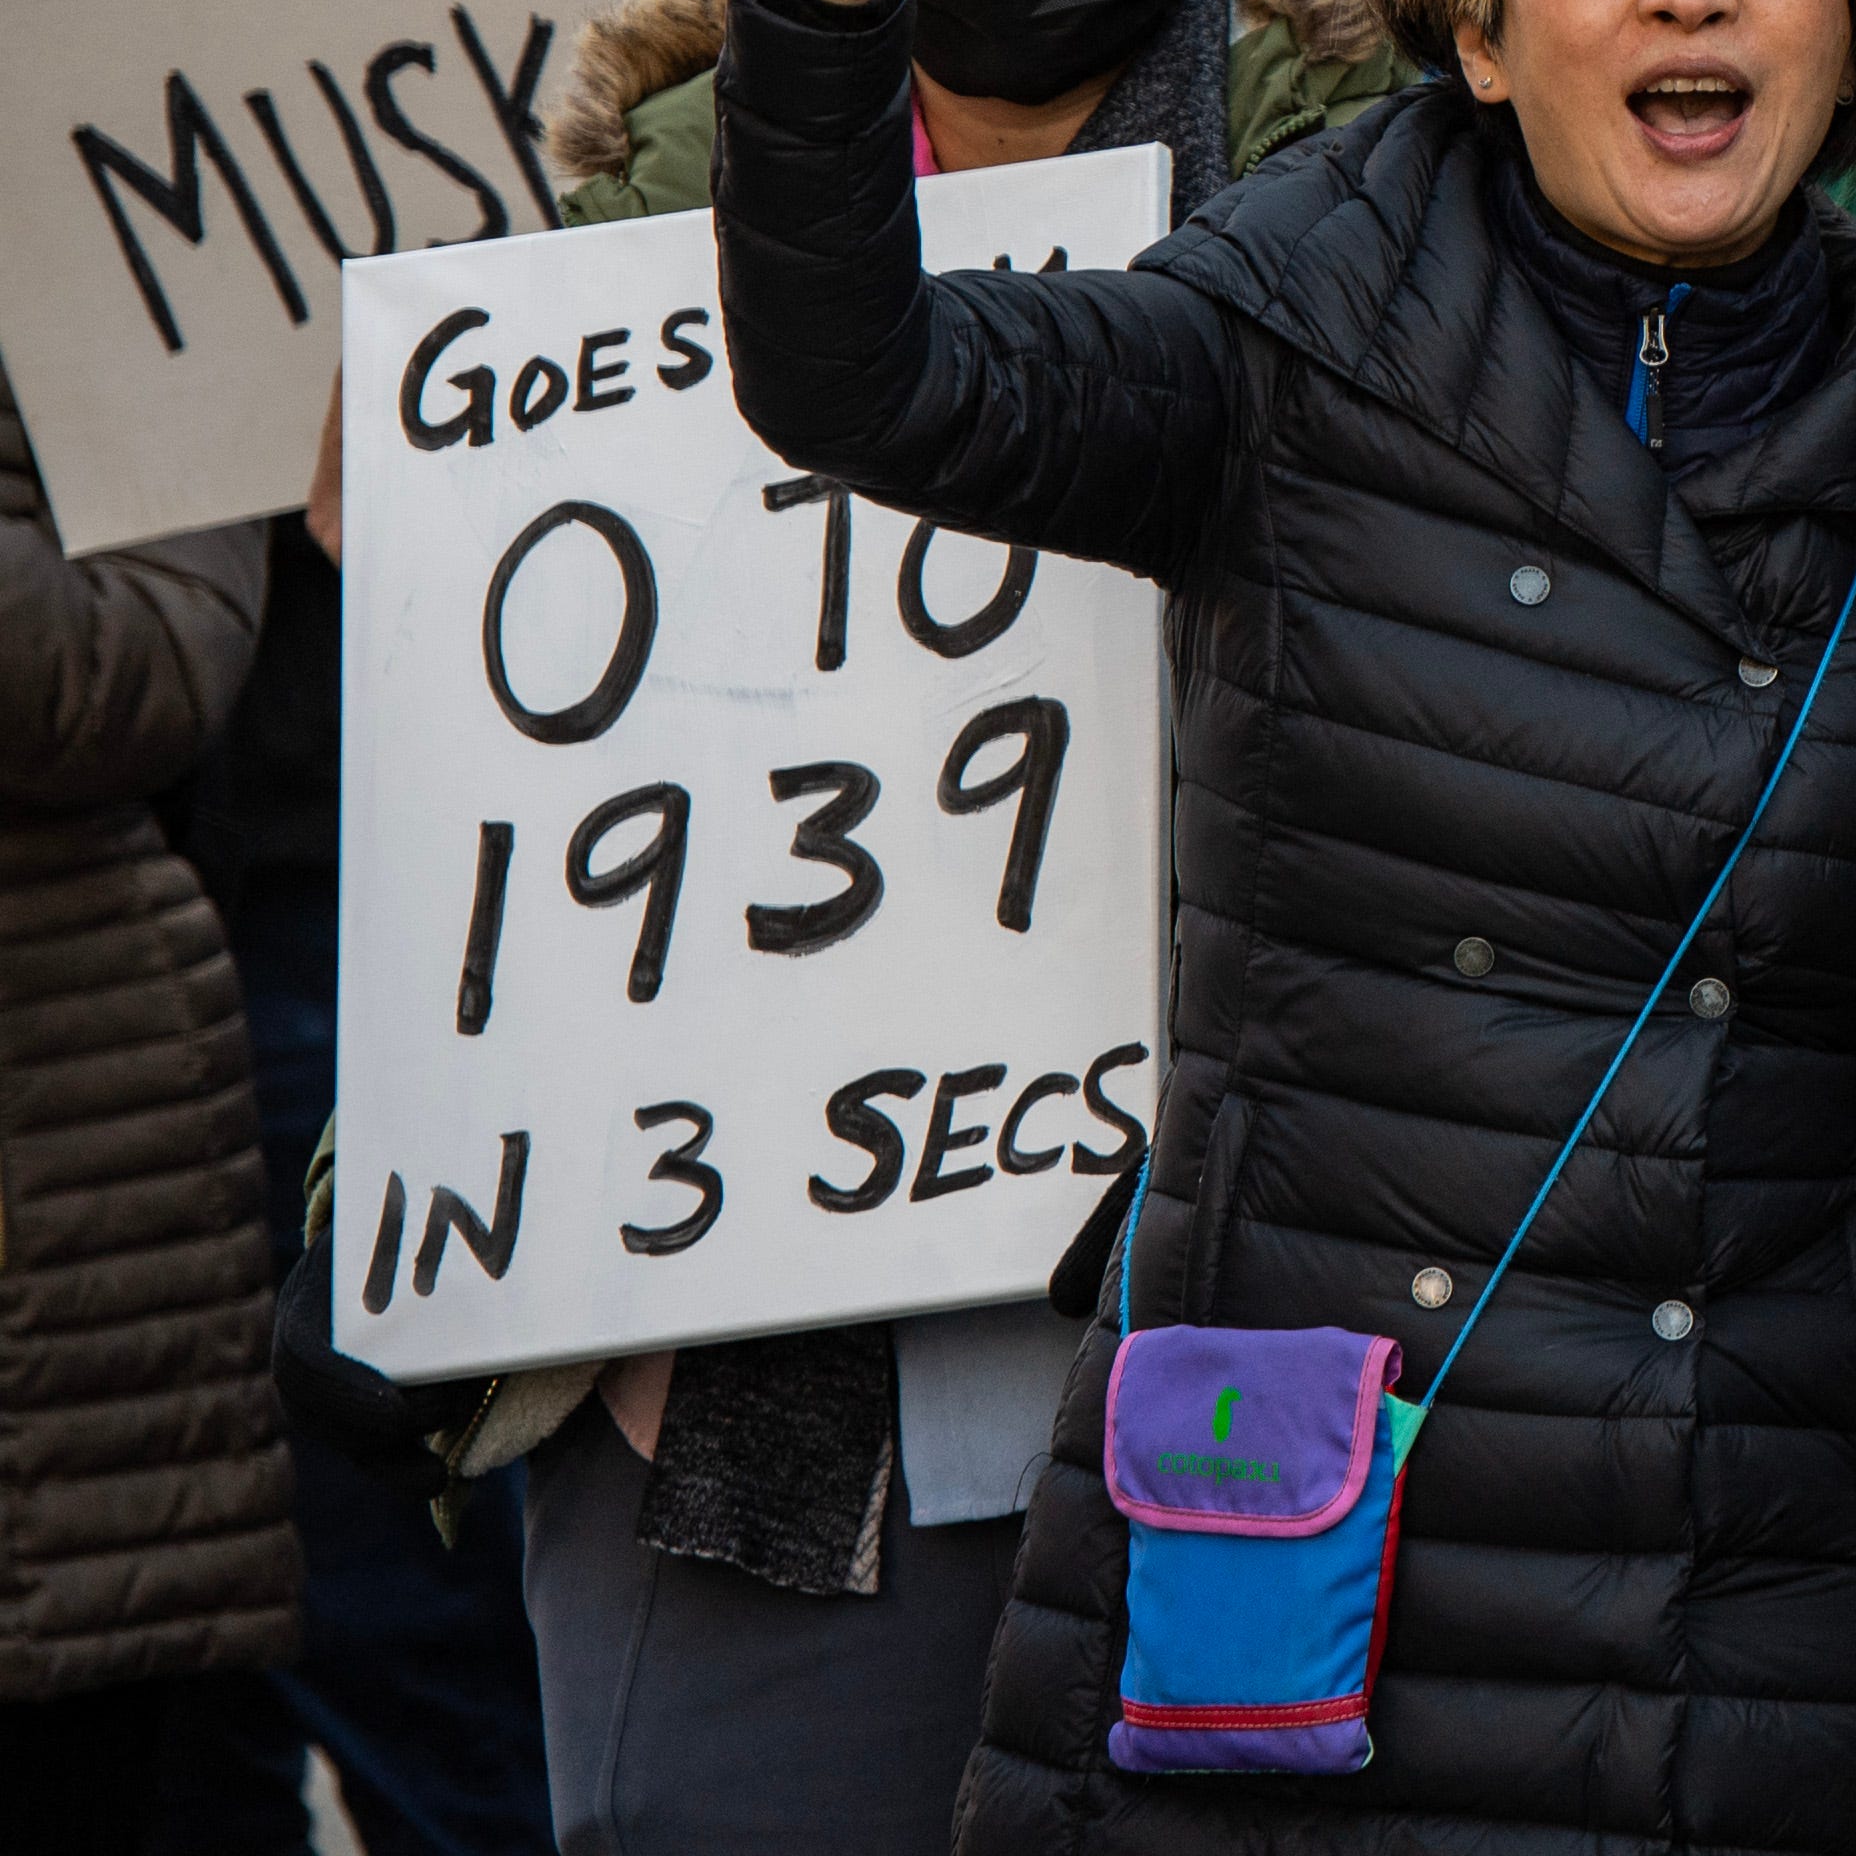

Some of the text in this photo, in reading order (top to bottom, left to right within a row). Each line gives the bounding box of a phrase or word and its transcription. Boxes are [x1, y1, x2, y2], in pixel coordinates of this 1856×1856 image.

[72, 3, 561, 352] MUSK
[399, 307, 713, 450] GOES
[762, 472, 1037, 672] TO
[456, 695, 1070, 1036] 1939
[363, 1040, 1149, 1314] IN 3 SECS
[1157, 1451, 1281, 1485] cotopaxi
